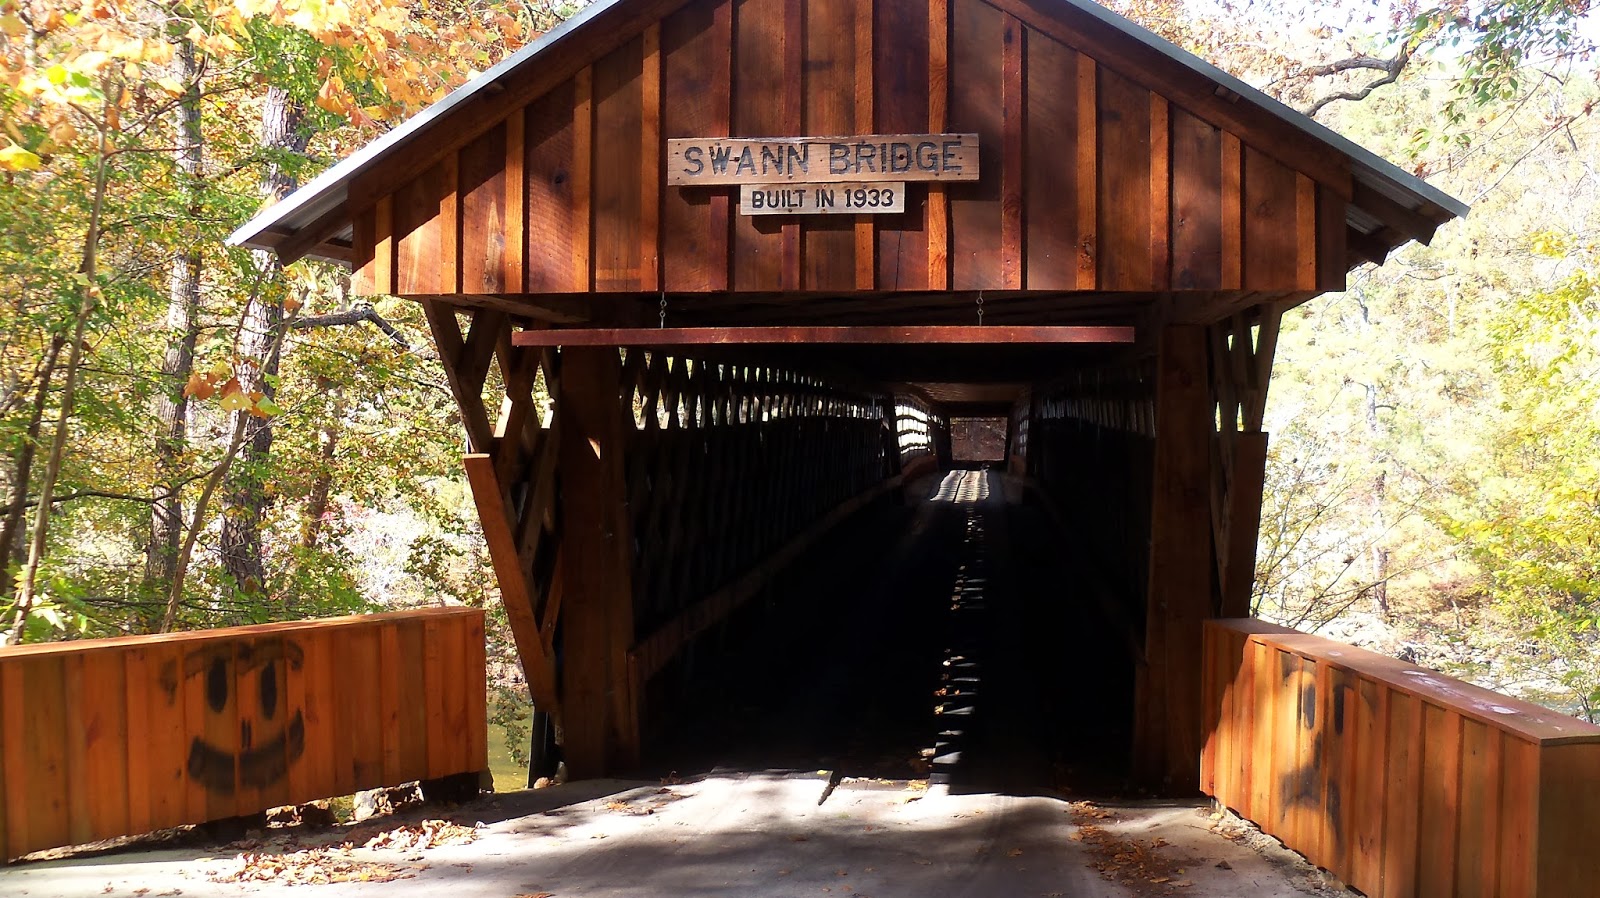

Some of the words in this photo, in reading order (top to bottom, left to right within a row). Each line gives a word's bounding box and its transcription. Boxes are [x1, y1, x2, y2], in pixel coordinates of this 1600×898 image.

[683, 145, 809, 176] SWANN
[829, 141, 962, 175] BRIDGE
[751, 189, 807, 209] BUILT
[815, 188, 835, 208] IN
[845, 188, 894, 208] 1933
